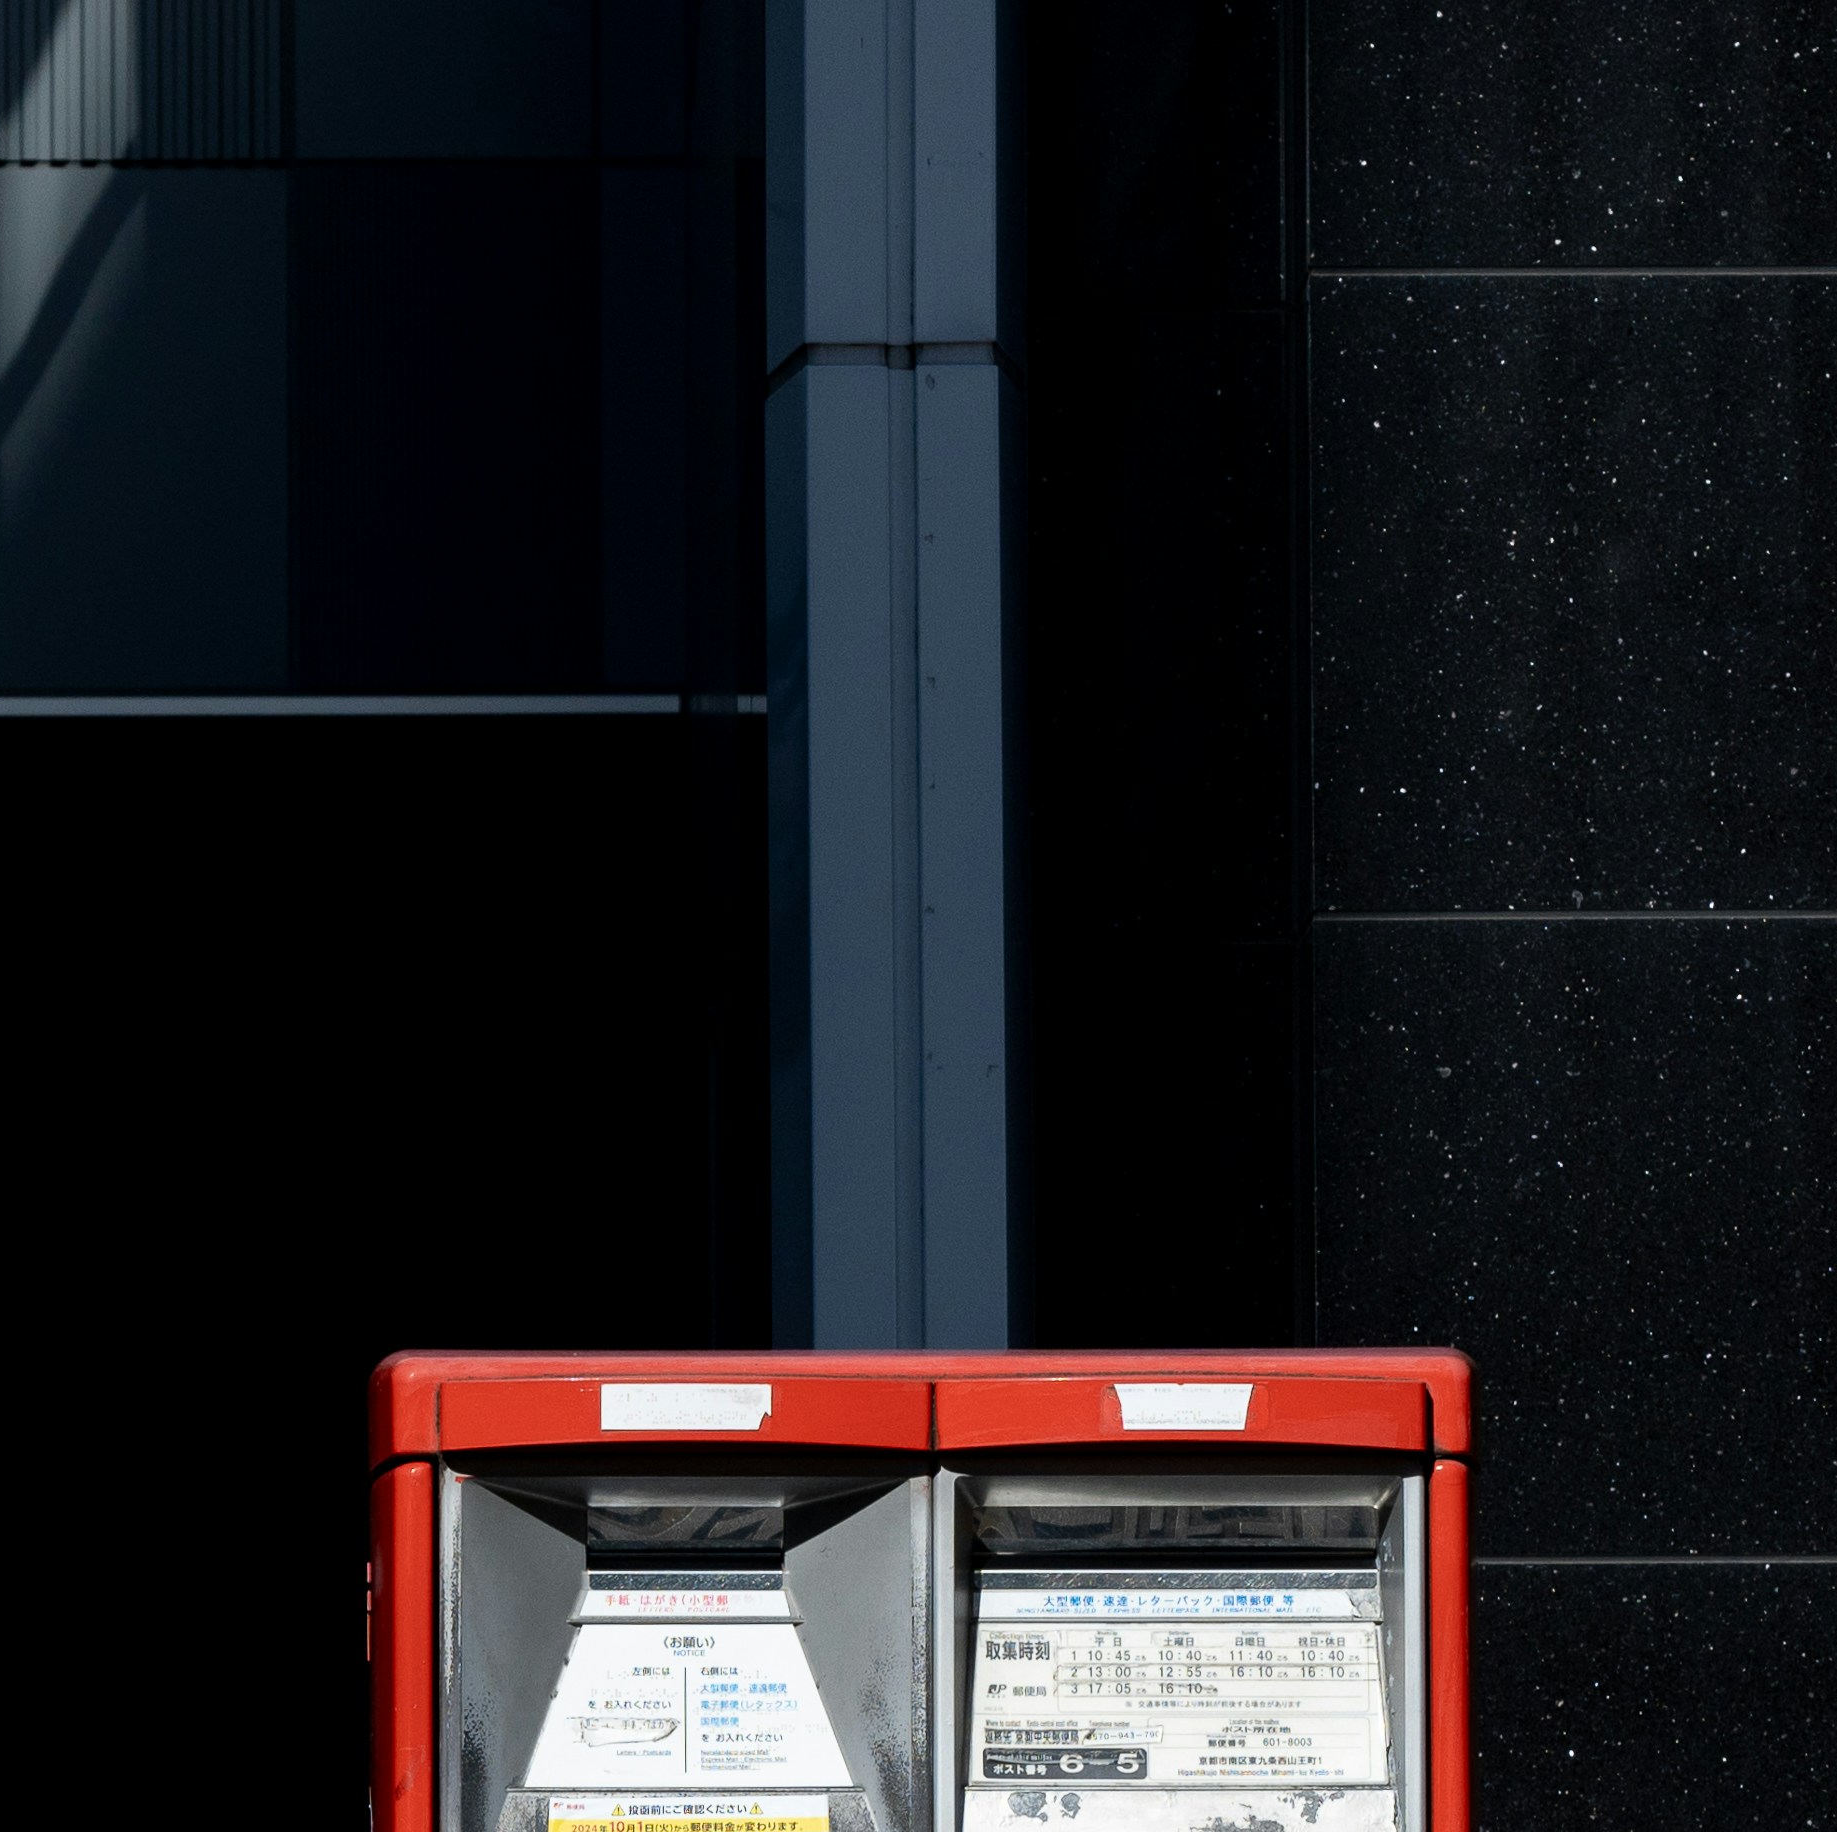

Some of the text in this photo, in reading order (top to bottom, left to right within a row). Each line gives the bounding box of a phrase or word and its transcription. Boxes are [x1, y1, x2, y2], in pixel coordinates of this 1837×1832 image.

[1164, 1637, 1194, 1646] 土曜日
[1235, 1637, 1266, 1647] 日曜日
[1299, 1637, 1345, 1647] 祝日・休日
[673, 1649, 705, 1657] NOTICE
[986, 1641, 1050, 1661] 取集時刻
[632, 1667, 670, 1676] 左側には
[701, 1667, 738, 1676] 右側には
[1012, 1686, 1047, 1697] 郵便局
[1208, 1738, 1312, 1748] 郵便番号 601-8003
[993, 1764, 1047, 1775] ポスト番号
